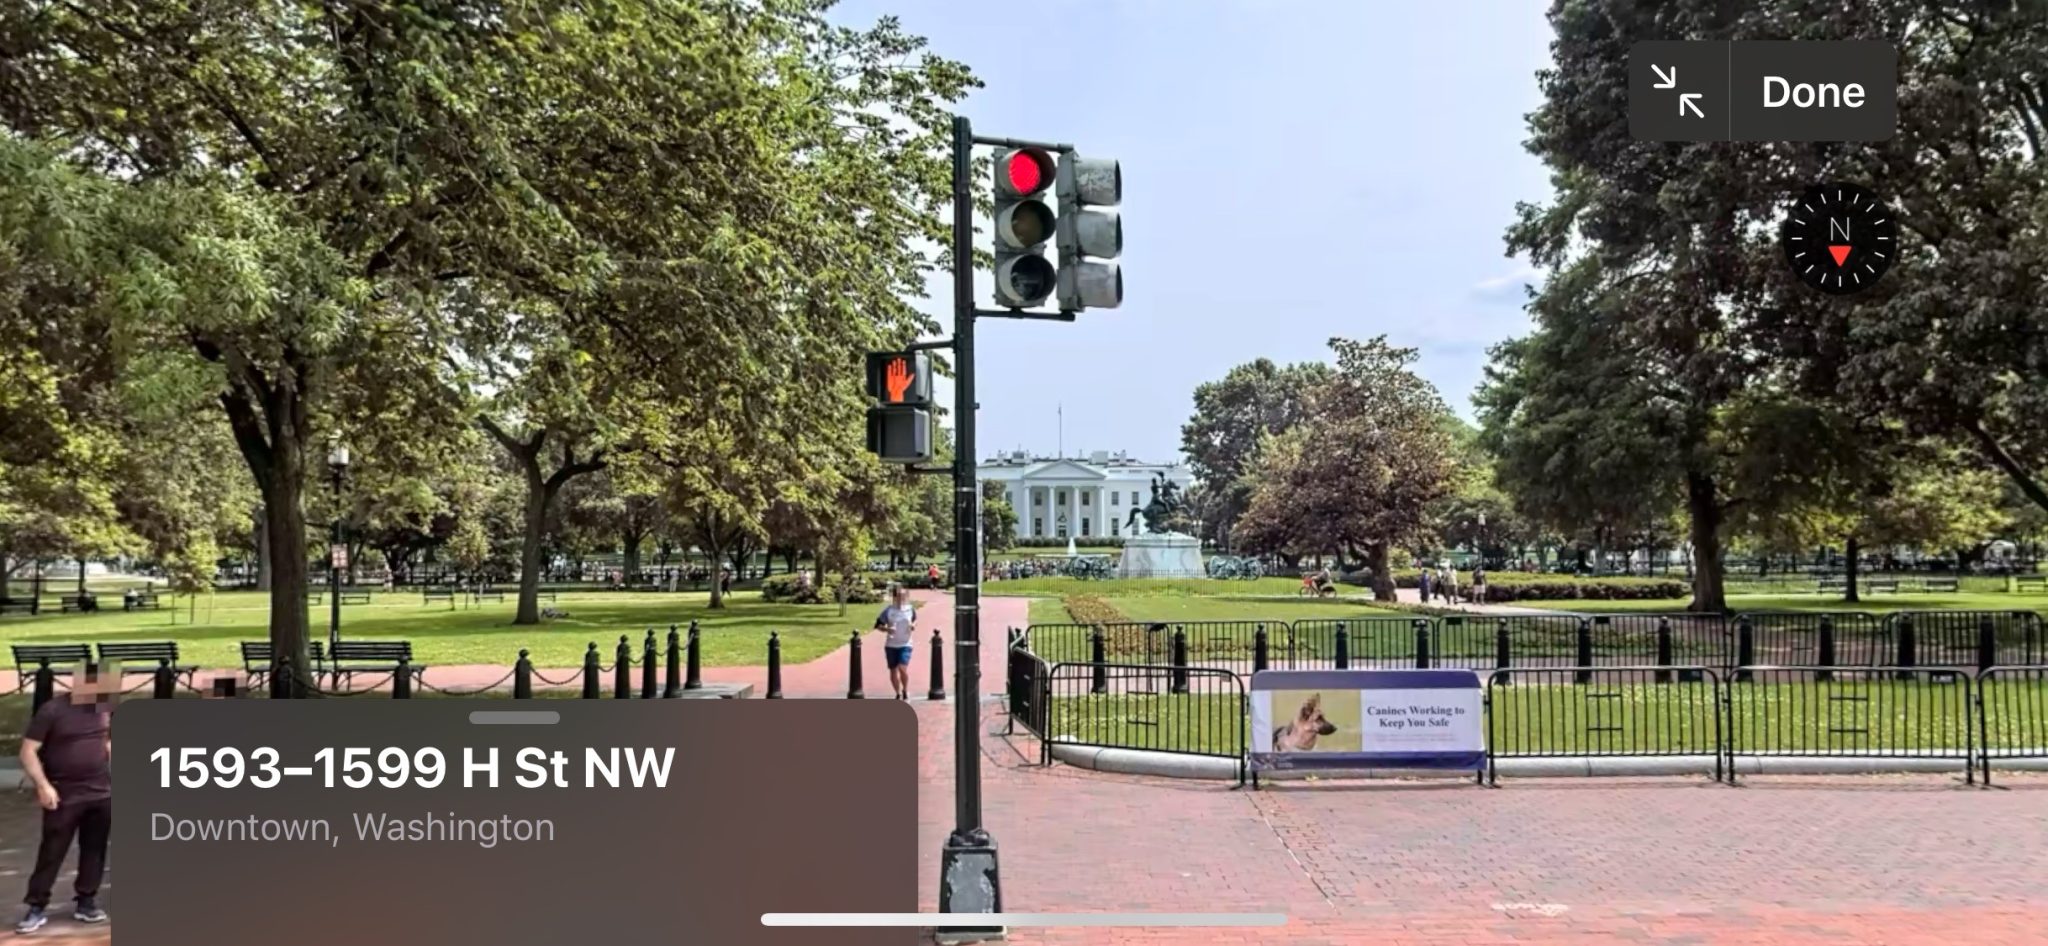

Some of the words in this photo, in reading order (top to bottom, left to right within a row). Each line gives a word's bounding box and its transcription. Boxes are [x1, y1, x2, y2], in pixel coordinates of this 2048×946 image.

[1367, 706, 1407, 716] Canines
[1409, 706, 1453, 716] Working
[1454, 707, 1465, 715] to
[1379, 719, 1405, 730] Keep
[1407, 718, 1426, 727] You
[1428, 718, 1450, 727] Safe
